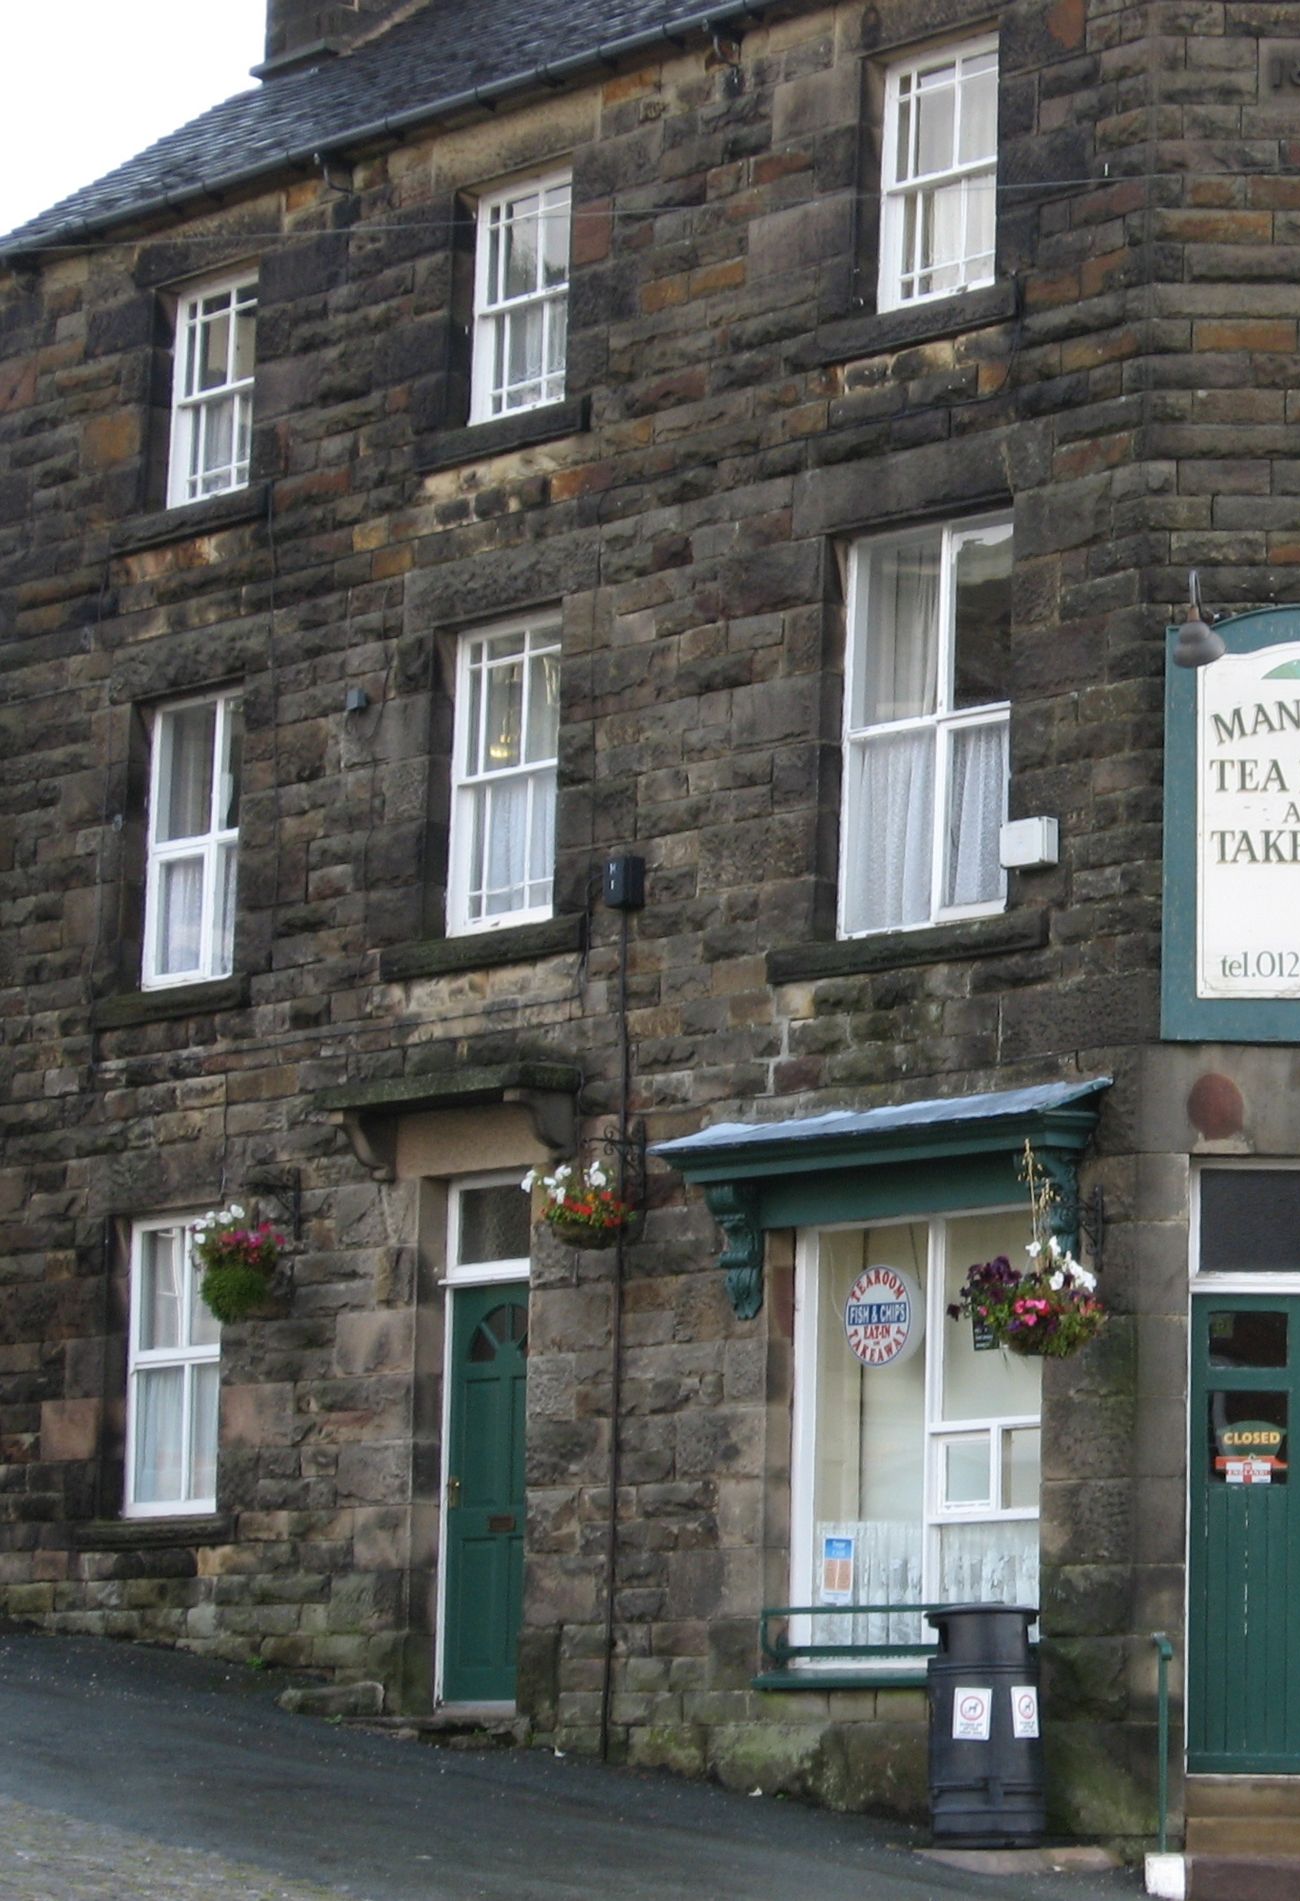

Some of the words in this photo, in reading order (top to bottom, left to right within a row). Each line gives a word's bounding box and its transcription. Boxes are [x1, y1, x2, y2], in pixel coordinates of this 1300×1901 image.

[1210, 759, 1289, 793] TEA
[850, 1269, 904, 1302] TEAROOM
[850, 1305, 870, 1324] FISH
[871, 1304, 880, 1323] &
[880, 1303, 905, 1322] CHIPS
[849, 1326, 906, 1362] TAKEAWAY
[864, 1325, 890, 1340] EAT-IN
[1223, 1432, 1281, 1445] CLOSED
